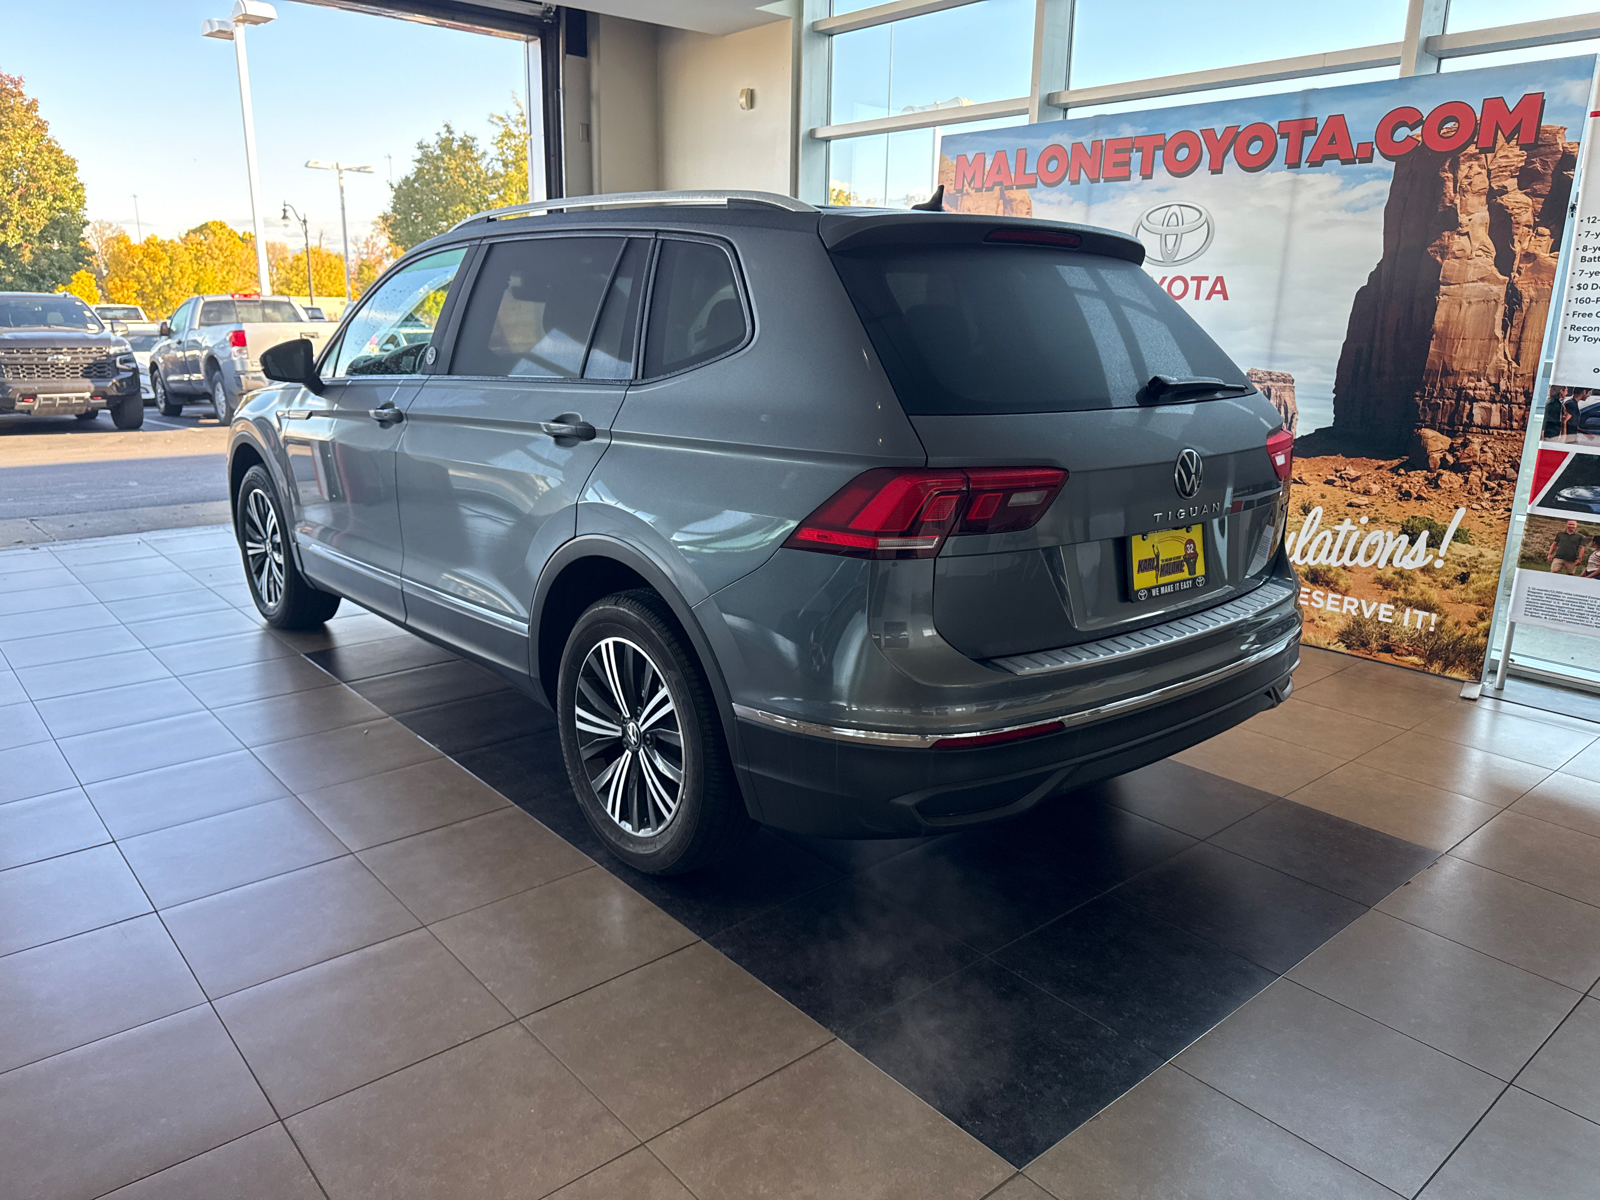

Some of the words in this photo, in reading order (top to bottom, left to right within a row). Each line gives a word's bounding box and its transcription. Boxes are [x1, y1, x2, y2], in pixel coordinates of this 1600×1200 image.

[953, 91, 1546, 192] MALONETOYOTA.COM
[1576, 283, 1589, 291] $0
[1568, 334, 1581, 344] by
[1153, 502, 1220, 523] TIGUAN
[1186, 543, 1194, 554] 32
[1151, 587, 1160, 597] WE
[1160, 585, 1174, 595] MAKE
[1174, 582, 1180, 591] IT
[1180, 580, 1192, 589] EASY
[1403, 608, 1437, 632] IT!
